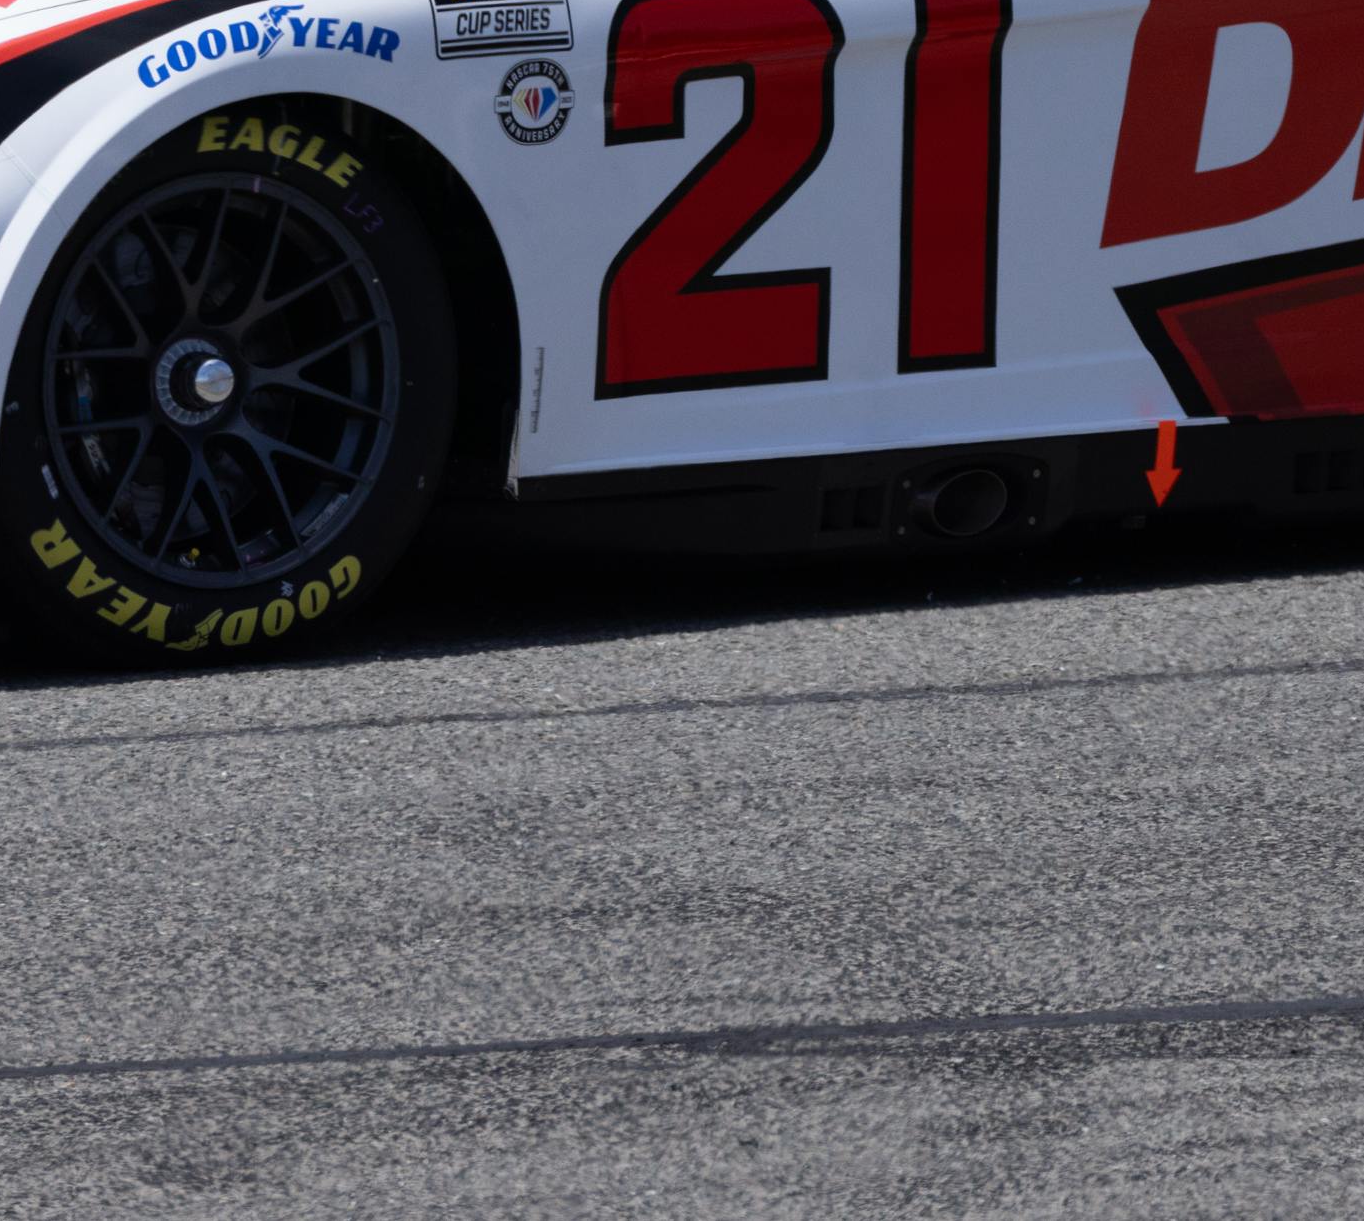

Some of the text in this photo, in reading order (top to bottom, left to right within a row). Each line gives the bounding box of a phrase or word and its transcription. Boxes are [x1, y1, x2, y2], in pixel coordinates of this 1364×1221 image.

[456, 7, 551, 36] CUP SERIES
[506, 62, 540, 90] NASCAR
[504, 112, 565, 143] ANNIVERSARY
[197, 115, 364, 189] EAGLE
